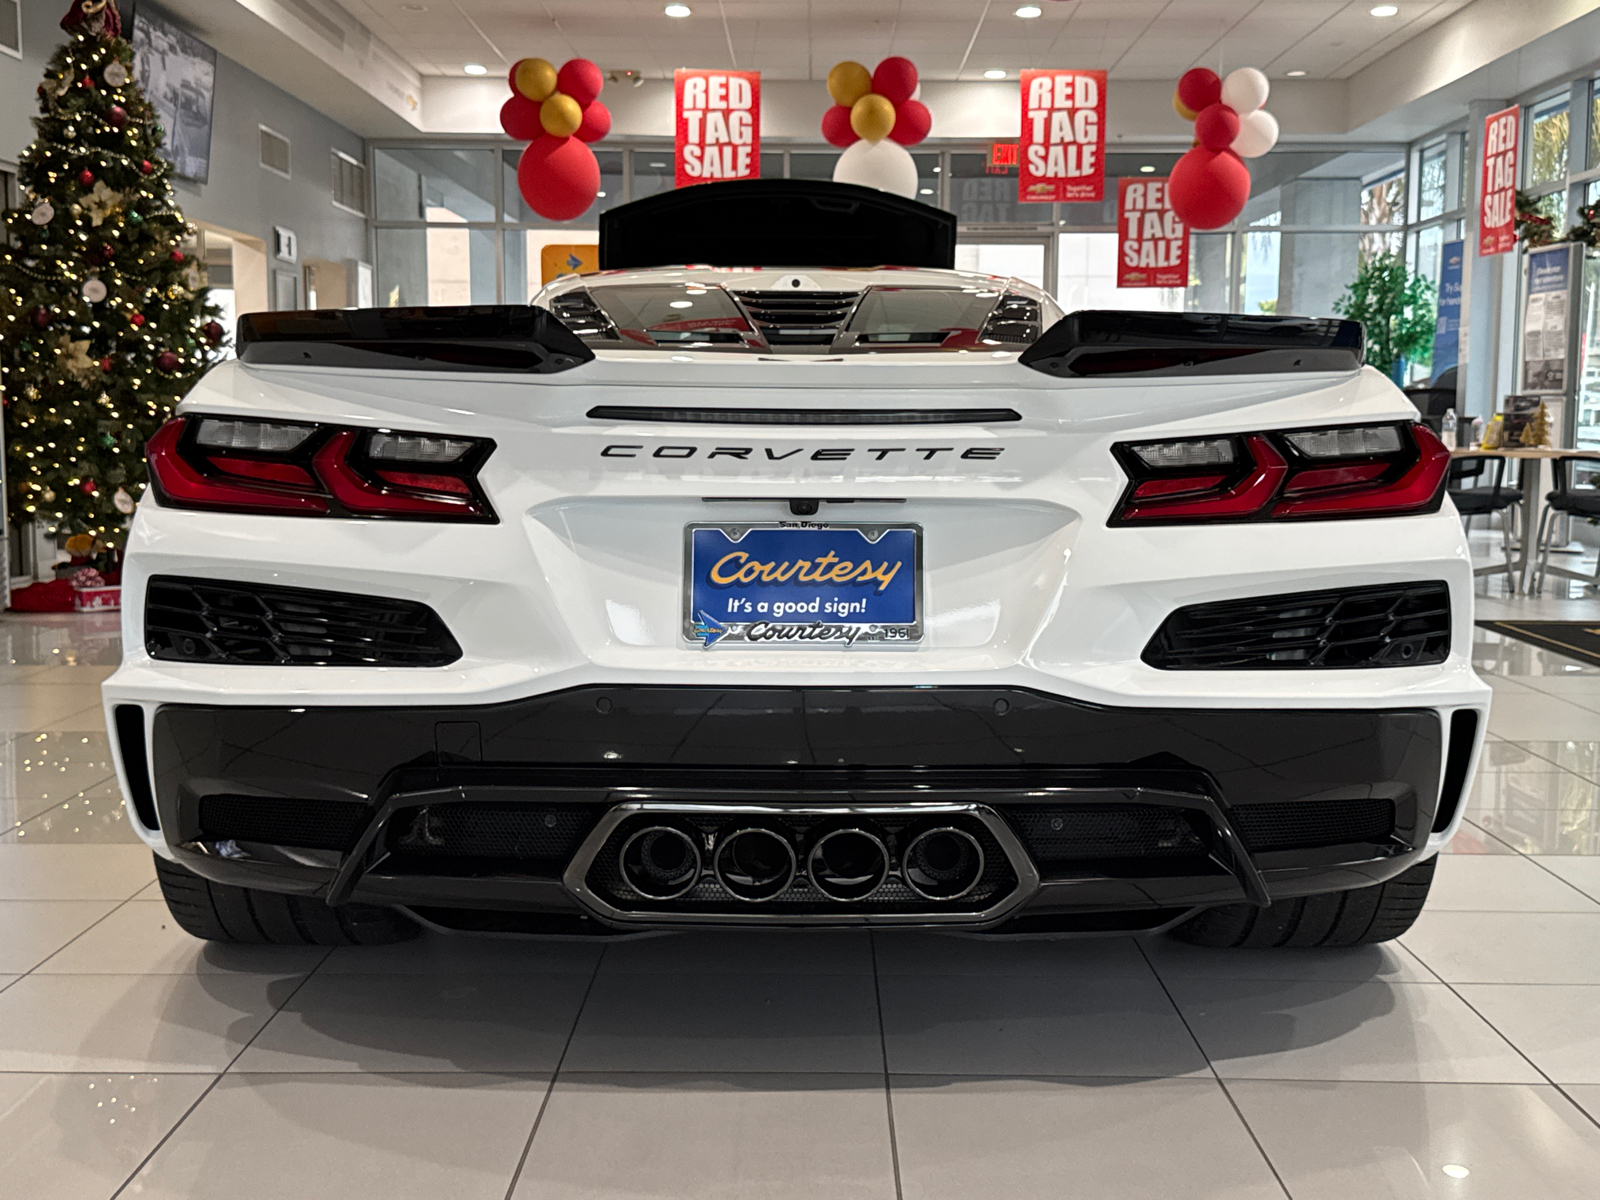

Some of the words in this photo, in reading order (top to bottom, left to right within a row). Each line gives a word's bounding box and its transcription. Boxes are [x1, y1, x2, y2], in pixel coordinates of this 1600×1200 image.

[683, 75, 752, 109] RED
[1028, 75, 1098, 109] RED
[683, 110, 753, 145] TAG
[1027, 109, 1098, 144] TAG
[1487, 114, 1516, 157] RED
[683, 144, 752, 179] SALE
[992, 143, 1019, 165] EXIT
[1027, 144, 1097, 178] SALE
[1486, 150, 1514, 194] TAG
[1124, 210, 1184, 240] TAG
[1484, 188, 1513, 229] SALE
[1123, 239, 1183, 268] SALE
[600, 445, 1005, 461] CORVETTE
[801, 521, 829, 529] Diego
[709, 550, 902, 592] Courtesy
[757, 602, 768, 613] a
[773, 597, 820, 617] good
[824, 597, 867, 617] sign!
[746, 620, 861, 646] Courtesy
